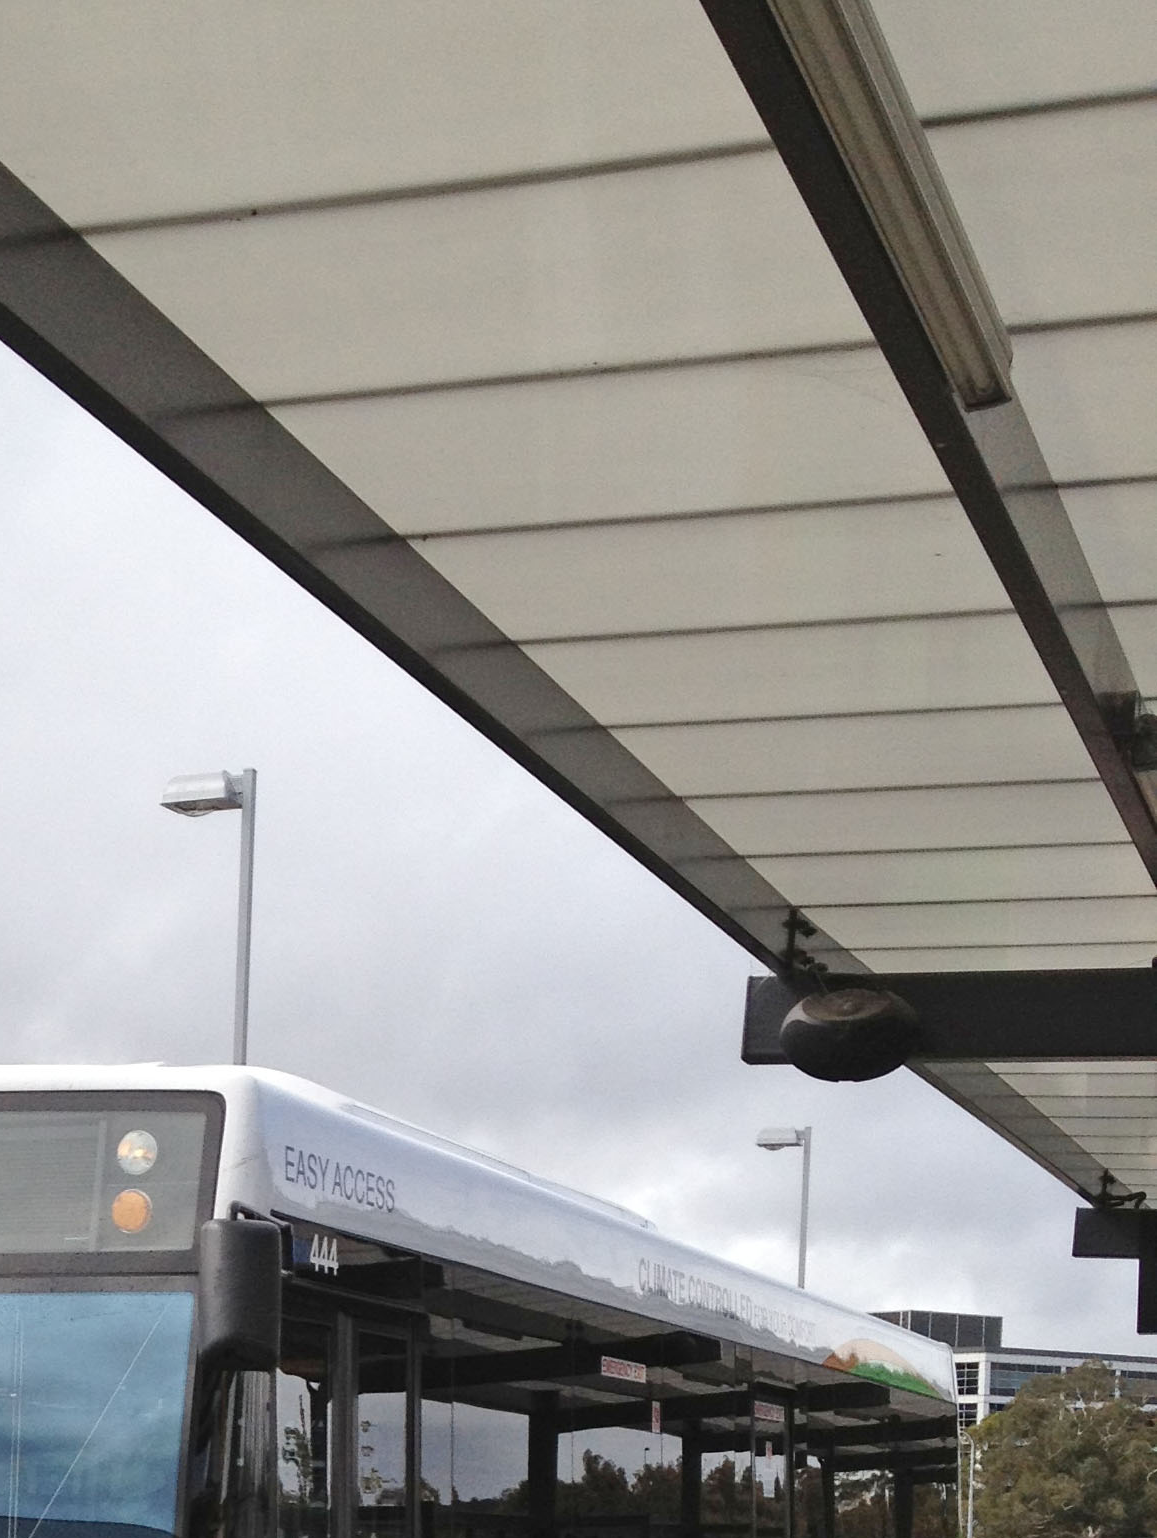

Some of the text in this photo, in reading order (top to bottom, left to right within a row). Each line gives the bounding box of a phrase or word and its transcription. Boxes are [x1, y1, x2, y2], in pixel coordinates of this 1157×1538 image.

[285, 1145, 395, 1213] EASY ACCESS
[310, 1233, 339, 1276] 444
[638, 1257, 685, 1303] CLIMATE
[688, 1275, 752, 1325] CONTROLLED
